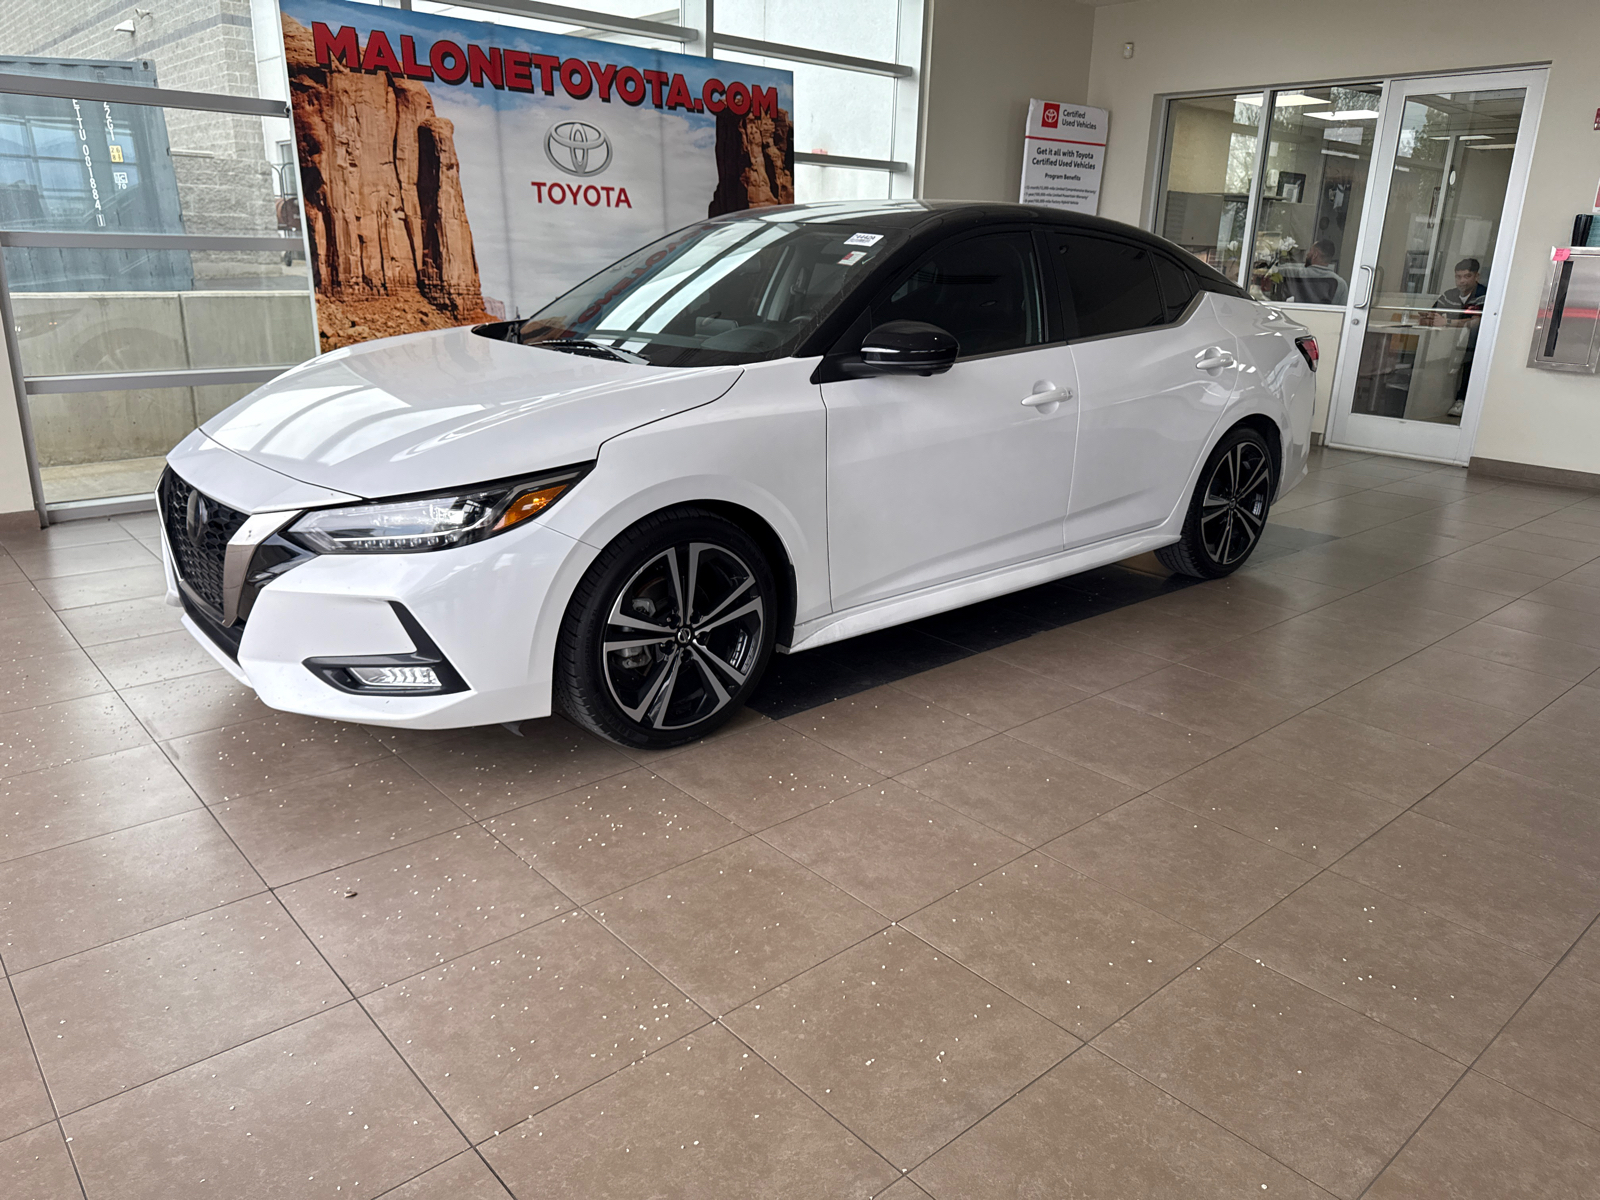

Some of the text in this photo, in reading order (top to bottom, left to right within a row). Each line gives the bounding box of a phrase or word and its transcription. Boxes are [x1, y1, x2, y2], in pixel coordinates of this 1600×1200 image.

[311, 21, 778, 119] MALONETOYOTA.COM
[1062, 109, 1086, 119] Certified
[1062, 119, 1096, 130] Used Vehicles
[1036, 146, 1048, 156] Get
[1048, 148, 1052, 156] it
[1062, 149, 1074, 158] with
[1076, 150, 1094, 160] Toyota
[1032, 158, 1096, 170] Certified Used Vehicles
[1044, 172, 1064, 181] Program
[531, 181, 632, 208] TOYOTA
